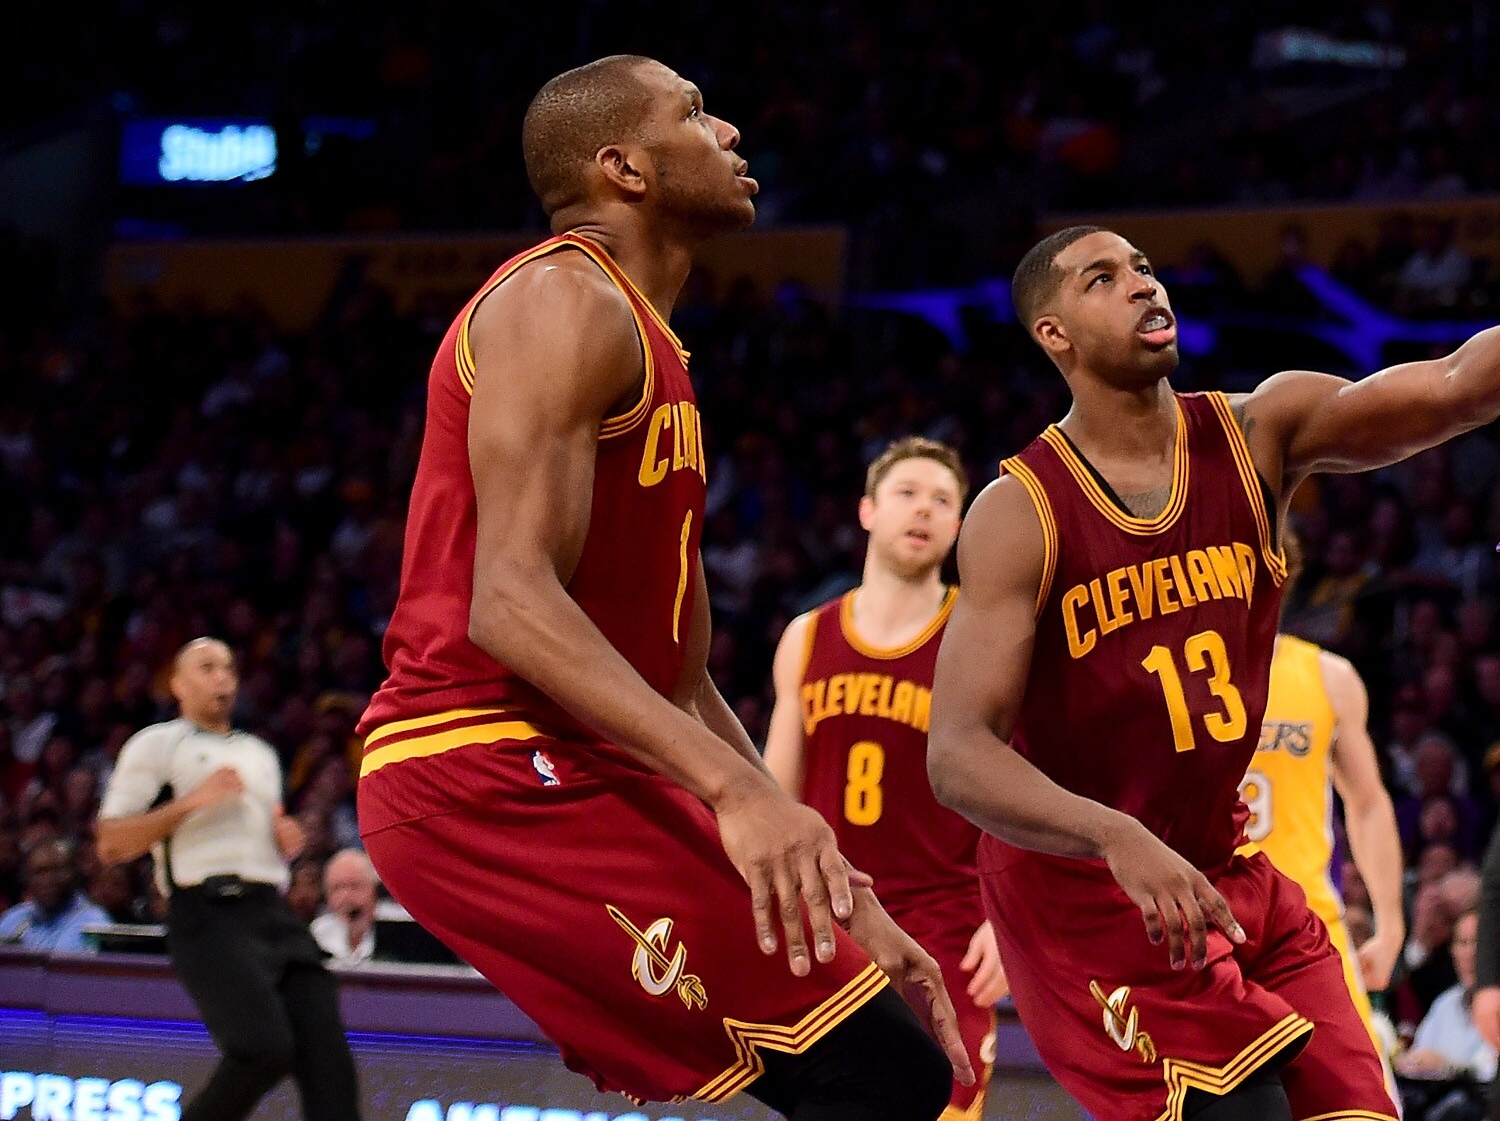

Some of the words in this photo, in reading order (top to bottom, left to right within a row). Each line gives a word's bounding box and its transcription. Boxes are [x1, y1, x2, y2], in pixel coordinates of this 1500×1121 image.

[1062, 542, 1256, 659] CLEVELAND
[1141, 630, 1247, 753] 13
[844, 740, 885, 827] 8
